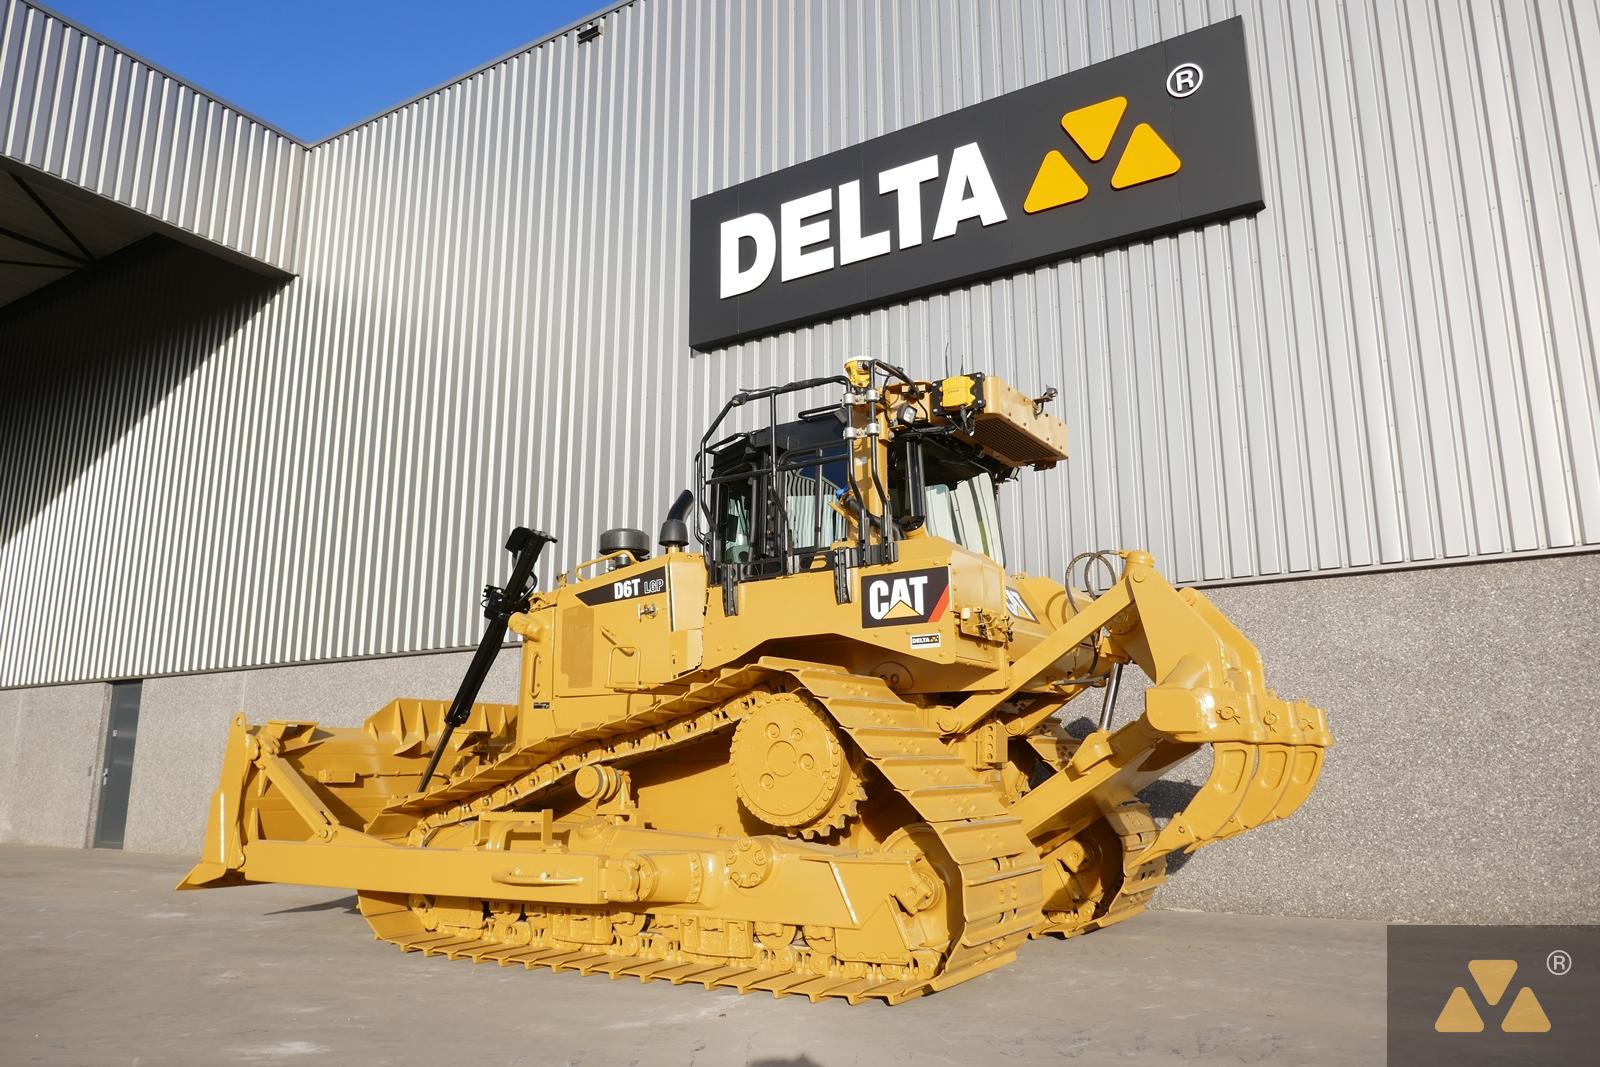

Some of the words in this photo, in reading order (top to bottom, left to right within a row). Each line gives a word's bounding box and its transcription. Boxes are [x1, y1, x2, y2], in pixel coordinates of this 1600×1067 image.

[719, 141, 1008, 300] DELTA
[614, 578, 641, 600] D6T
[644, 578, 664, 594] LGP
[869, 575, 928, 620] CAT
[912, 636, 930, 644] DELTA
